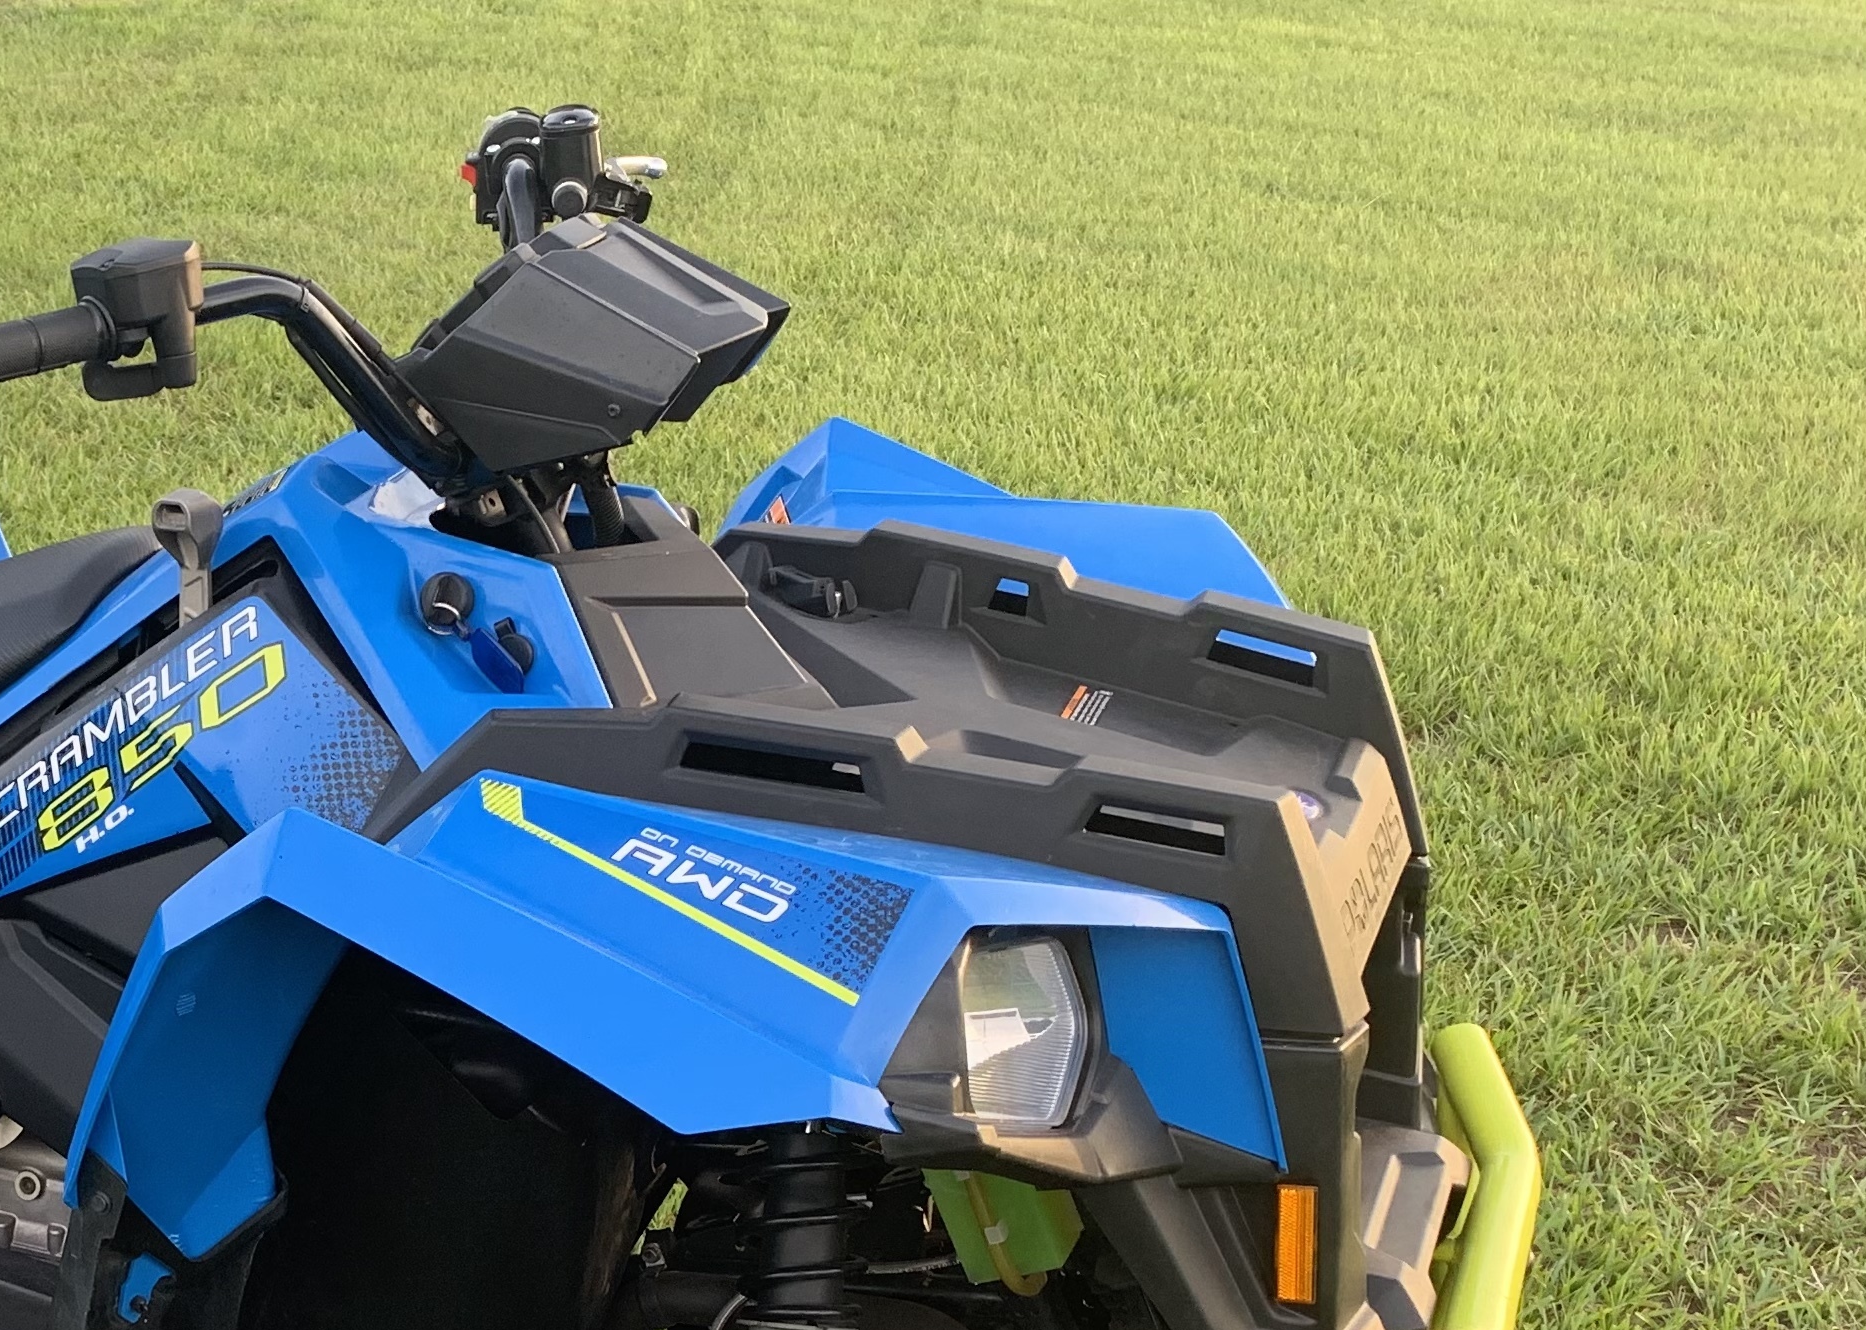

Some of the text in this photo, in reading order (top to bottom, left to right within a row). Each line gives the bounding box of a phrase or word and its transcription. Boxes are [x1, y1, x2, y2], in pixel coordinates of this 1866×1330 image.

[38, 642, 288, 852] 850
[75, 805, 135, 853] H.O.
[640, 827, 797, 895] ON DEMAND
[611, 838, 791, 923] AWD
